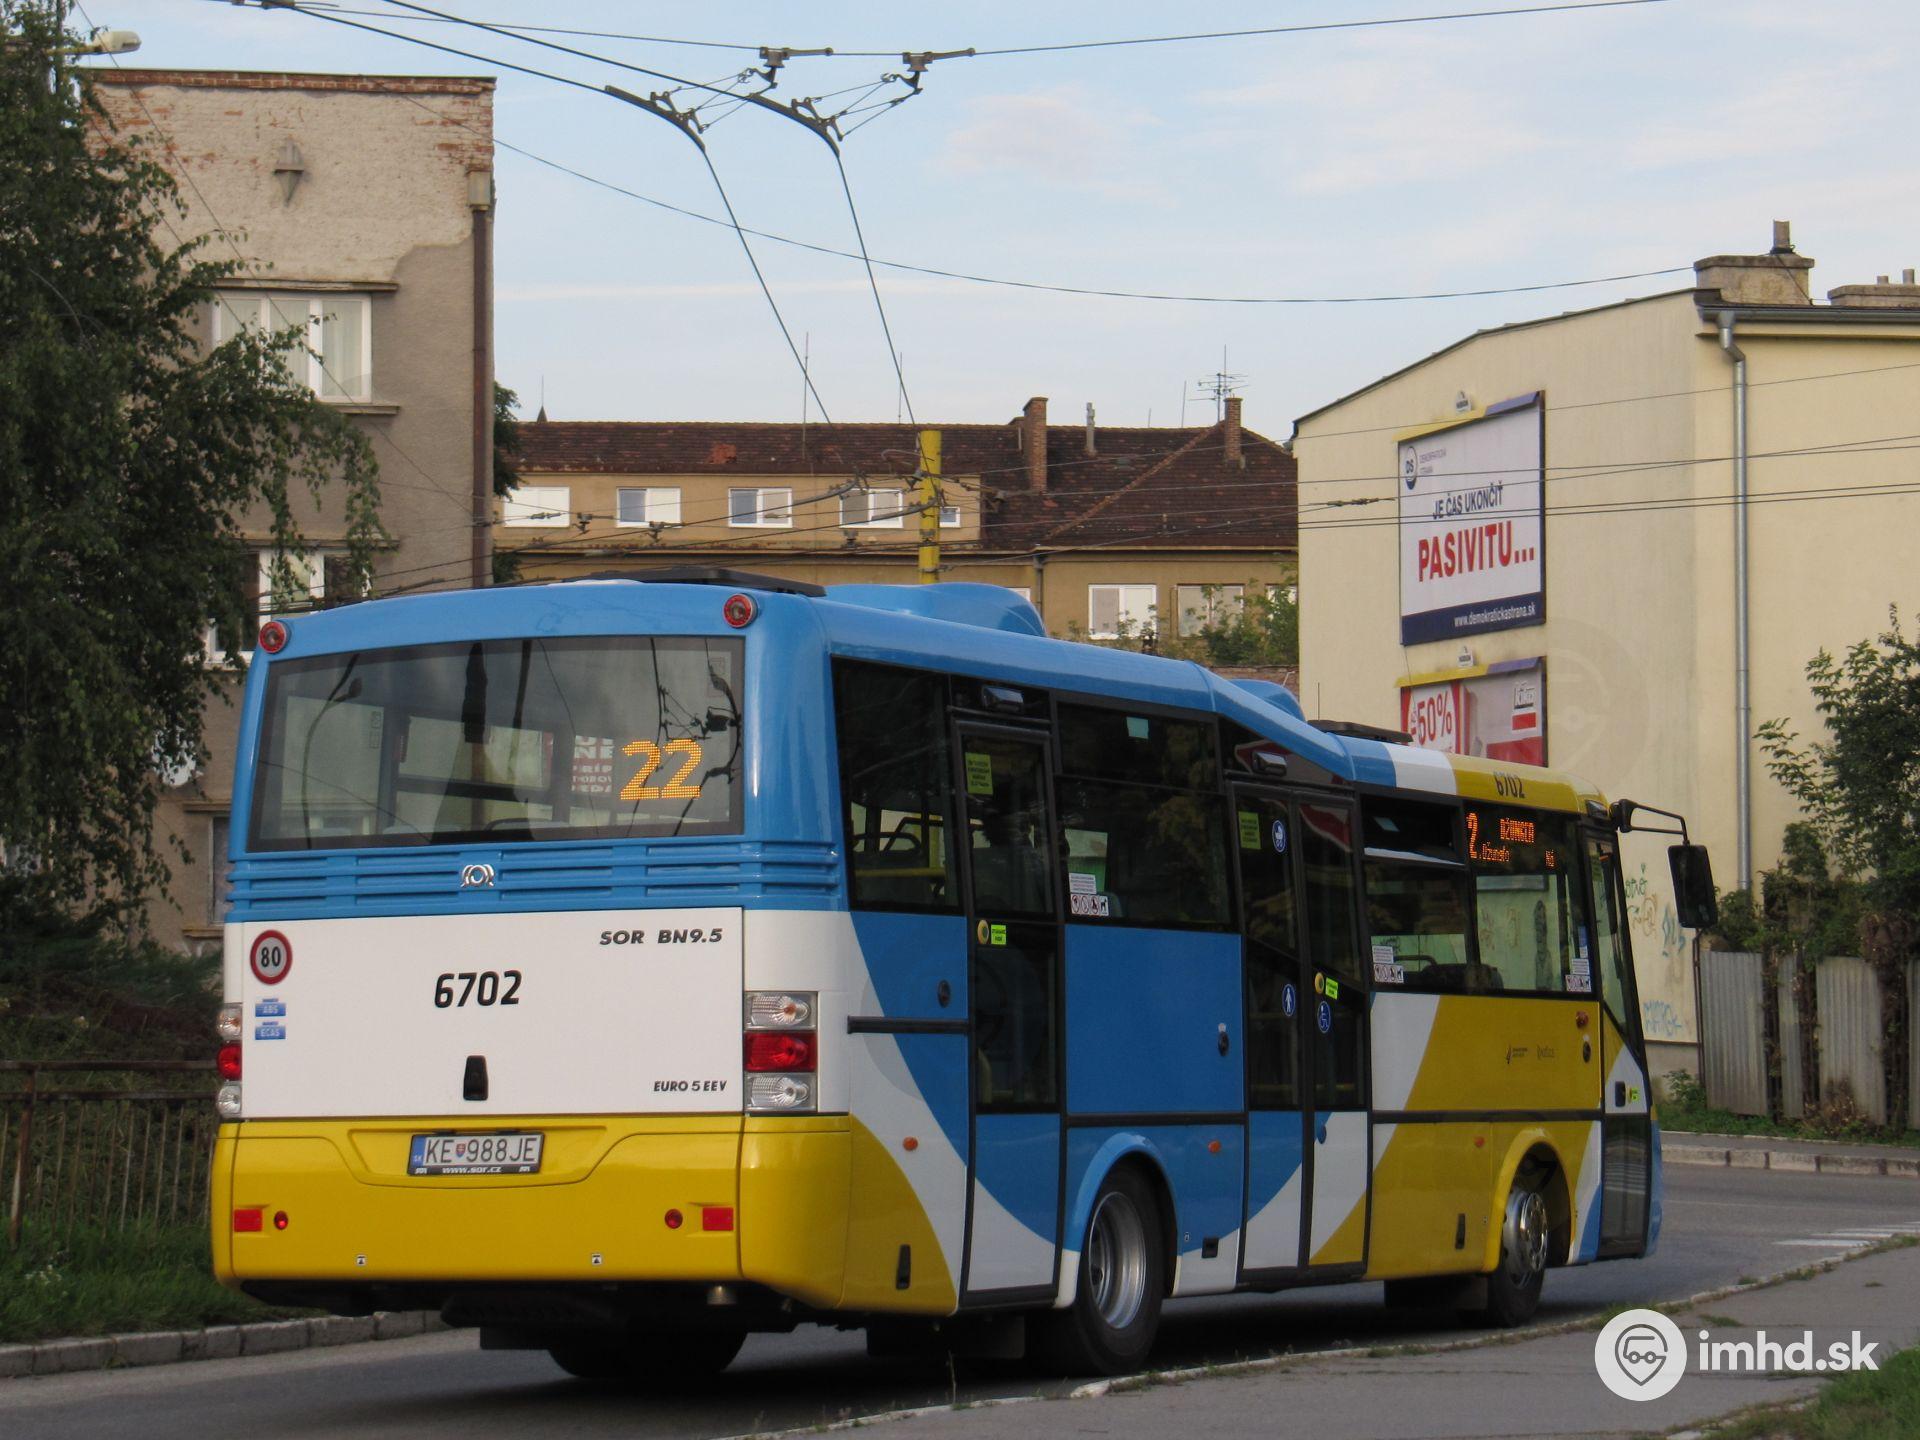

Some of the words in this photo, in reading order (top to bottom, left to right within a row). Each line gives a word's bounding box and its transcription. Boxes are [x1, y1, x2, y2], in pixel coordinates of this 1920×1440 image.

[1433, 499, 1444, 519] JE
[1445, 493, 1463, 516] ČAS
[1464, 480, 1504, 512] UKONČIŤ
[1418, 521, 1535, 582] PASIVITU...
[620, 738, 702, 800] 22
[599, 929, 645, 945] SOR
[657, 928, 723, 944] BN9.5
[261, 946, 281, 968] 80
[434, 970, 522, 1008] 6702
[653, 1080, 689, 1092] EURO
[691, 1080, 701, 1092] 5
[703, 1080, 728, 1092] EEV
[425, 1139, 456, 1163] KE
[442, 1166, 502, 1174] www.sor.cz
